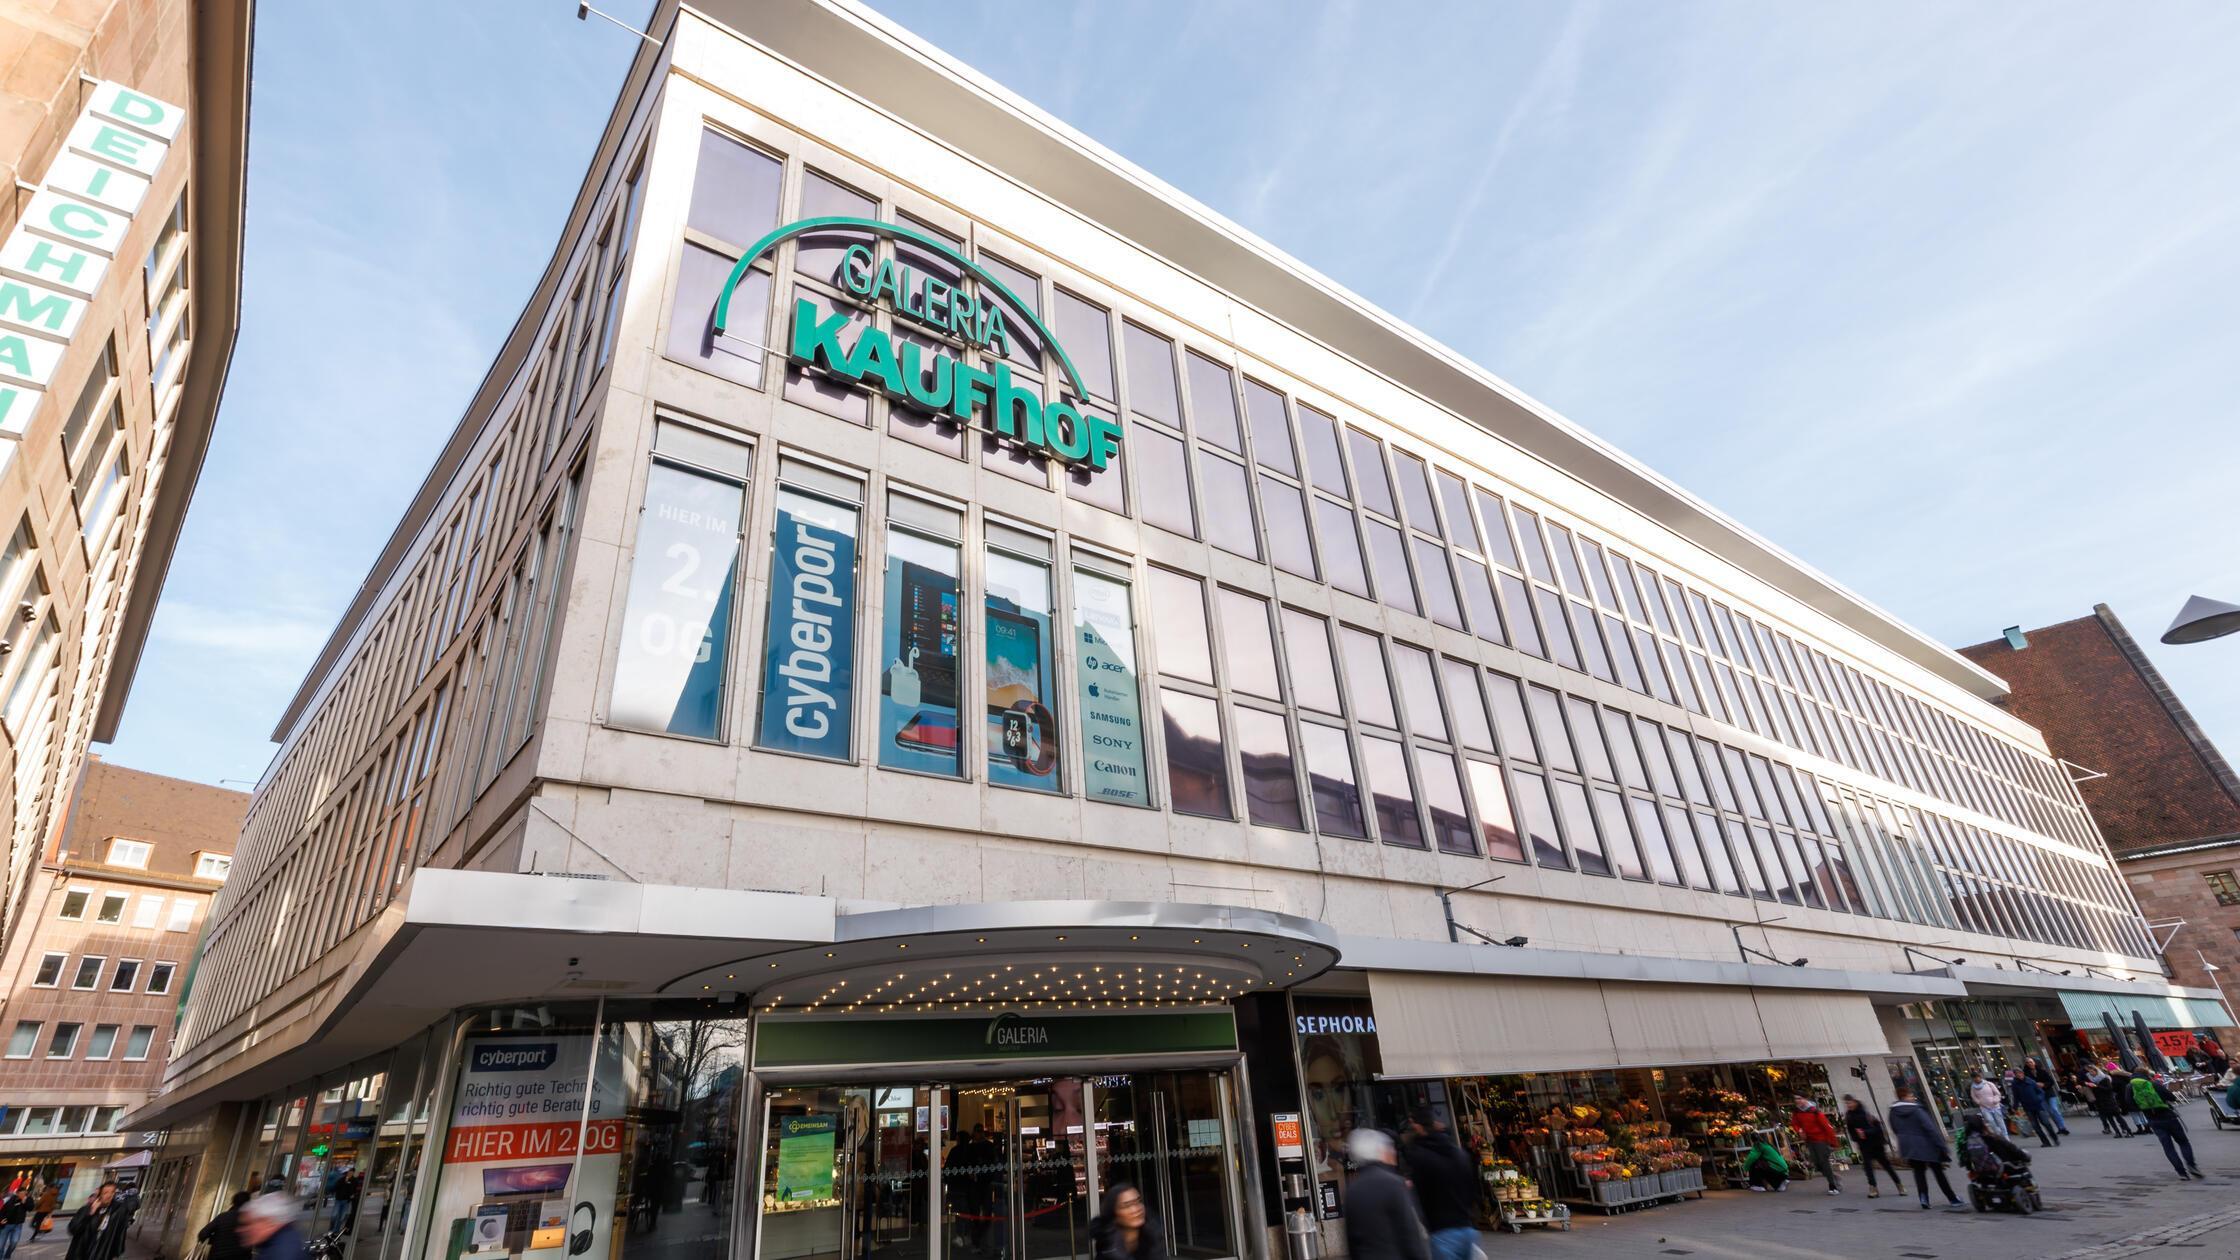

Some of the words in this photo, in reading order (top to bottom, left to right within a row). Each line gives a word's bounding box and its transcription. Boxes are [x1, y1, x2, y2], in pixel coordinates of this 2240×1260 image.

[842, 244, 1010, 358] GALERIA
[658, 503, 702, 528] HIER
[705, 516, 728, 535] IM
[778, 509, 843, 740] cyberport
[1101, 662, 1126, 673] acer
[1090, 711, 1131, 727] SAMSUNG
[1092, 734, 1133, 750] SONY
[1094, 759, 1137, 777] Canon
[1101, 787, 1138, 799] BOSE
[1296, 1015, 1377, 1034] SEPHORA
[997, 1026, 1049, 1045] GALERIA
[479, 1049, 547, 1067] cyberport
[465, 1081, 512, 1099] Richtig
[515, 1083, 545, 1099] gute
[550, 1079, 601, 1094] Technk,
[461, 1101, 504, 1119] richtig
[508, 1103, 538, 1118] gute
[542, 1099, 601, 1113] Beratug
[453, 1131, 514, 1158] HIER
[521, 1129, 551, 1154] IM
[1279, 1130, 1297, 1139] DEALS
